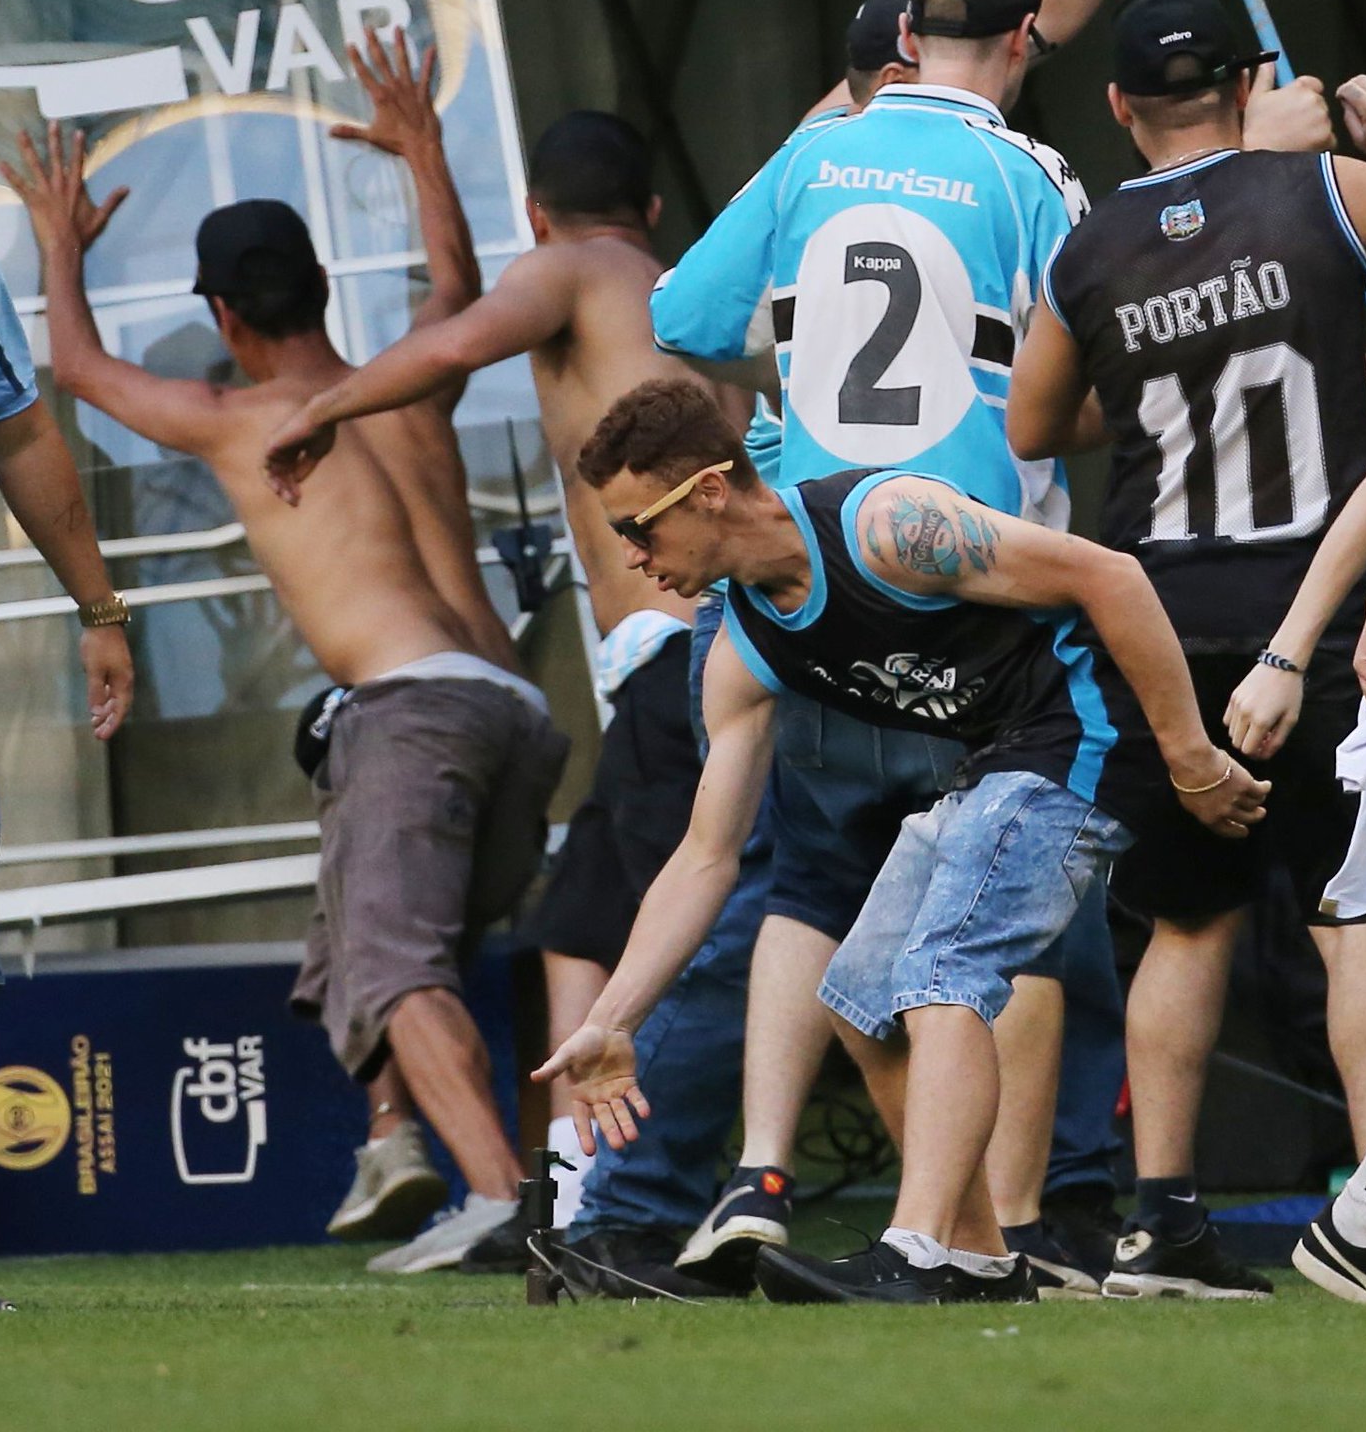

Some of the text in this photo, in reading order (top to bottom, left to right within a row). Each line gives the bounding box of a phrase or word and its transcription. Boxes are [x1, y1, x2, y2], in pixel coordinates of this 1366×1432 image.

[1158, 31, 1192, 45] umbro
[853, 255, 903, 272] Kappa
[1114, 255, 1292, 353] PORTÃO
[837, 241, 923, 426] 2
[1137, 340, 1332, 545] 10
[94, 1052, 114, 1110] 2021
[183, 1036, 239, 1123] cbf
[236, 1035, 266, 1101] VAR
[70, 1034, 98, 1195] BRASILEIRÃO
